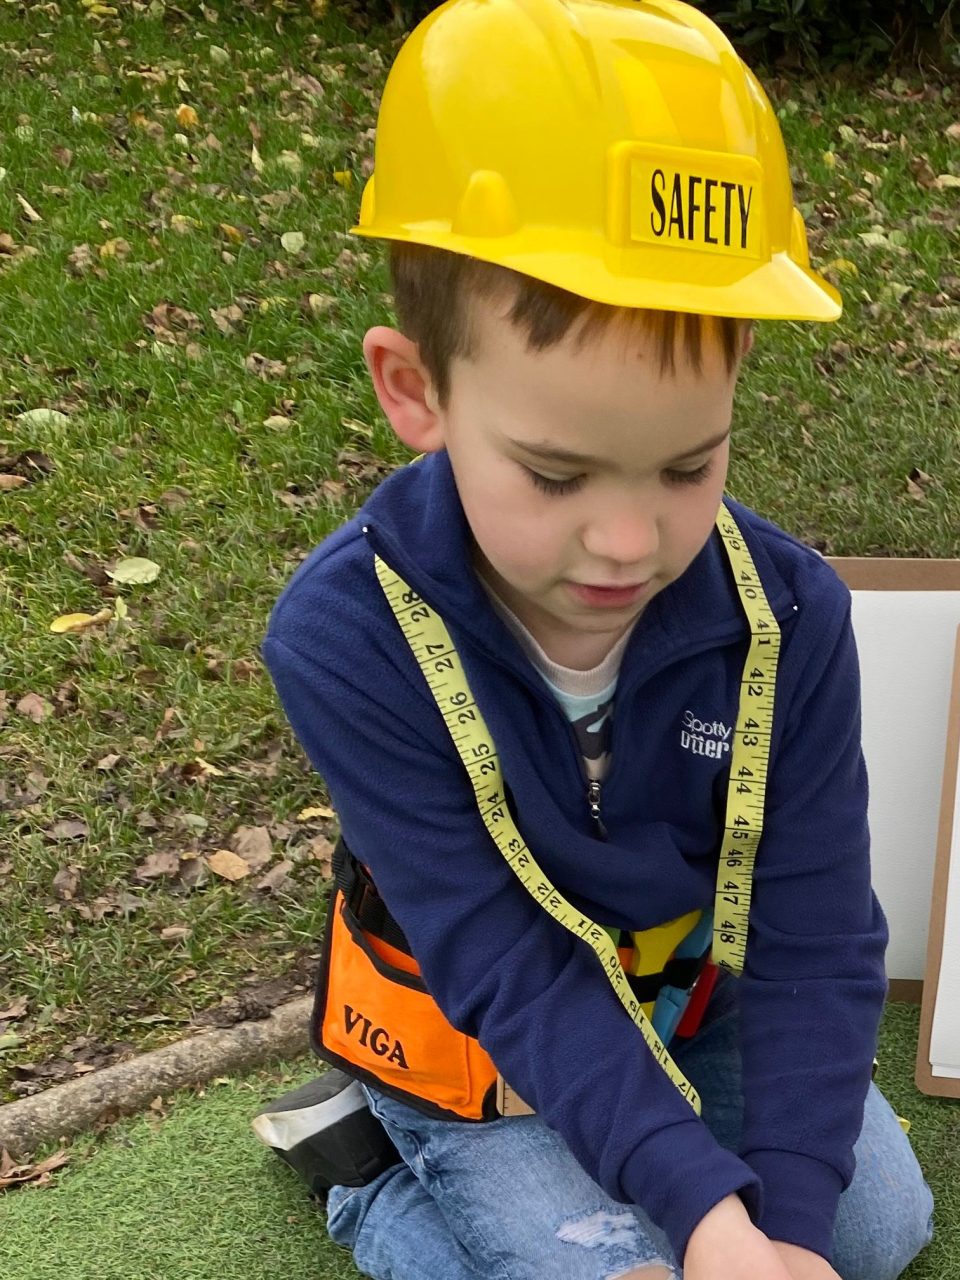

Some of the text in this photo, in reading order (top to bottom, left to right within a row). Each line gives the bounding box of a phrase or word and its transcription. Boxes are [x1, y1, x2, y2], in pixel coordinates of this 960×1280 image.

[651, 169, 752, 249] SAFETY
[722, 523, 741, 551] 39
[740, 570, 757, 600] 40
[402, 589, 431, 623] 28
[756, 618, 771, 647] 41
[425, 644, 454, 673] 27
[747, 667, 765, 697] 42
[449, 691, 476, 724] 26
[682, 710, 732, 741] Spotty
[742, 717, 760, 747] 43
[472, 743, 496, 775] 25
[736, 765, 754, 795] 44
[487, 790, 505, 823] 24
[732, 814, 750, 840] 45
[508, 838, 530, 868] 23
[726, 848, 744, 868] 46
[537, 882, 562, 909] 22
[722, 880, 740, 906] 47
[577, 918, 603, 941] 21
[719, 919, 736, 944] 48
[609, 955, 623, 985] 20
[629, 1000, 644, 1025] 19
[343, 1004, 410, 1070] VIGA
[677, 1081, 697, 1104] 17
